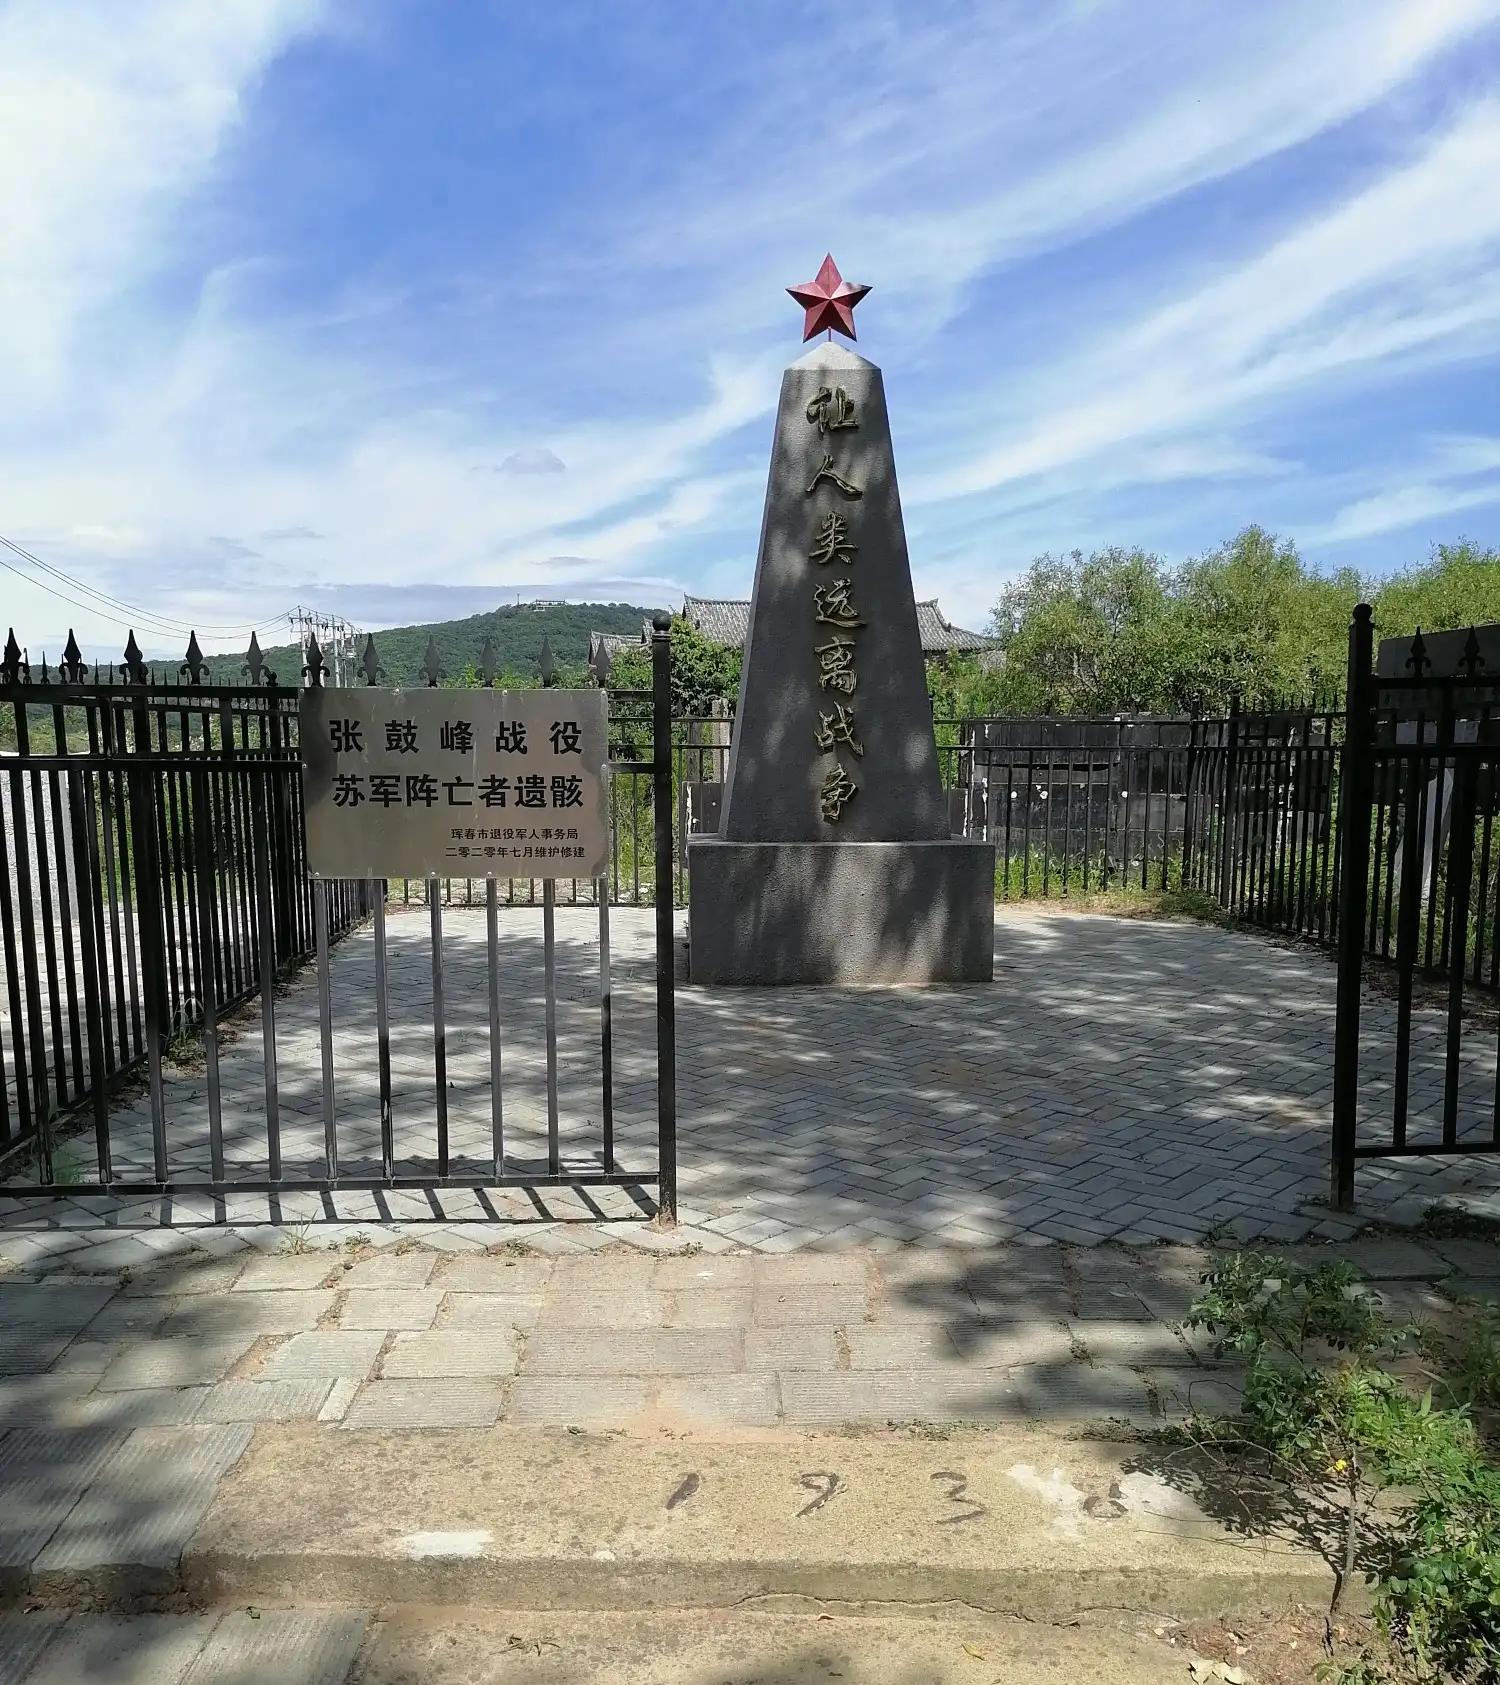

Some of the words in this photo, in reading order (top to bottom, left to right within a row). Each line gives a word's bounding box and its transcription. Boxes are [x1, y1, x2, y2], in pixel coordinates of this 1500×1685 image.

[806, 386, 866, 824] 让人类远离战争
[328, 719, 583, 754] 张鼓峰战役
[332, 774, 584, 808] 苏军阵亡者遗骸
[451, 828, 578, 840] 珲春市退役军人事务局
[445, 847, 585, 858] 二零二零年七月维护修建
